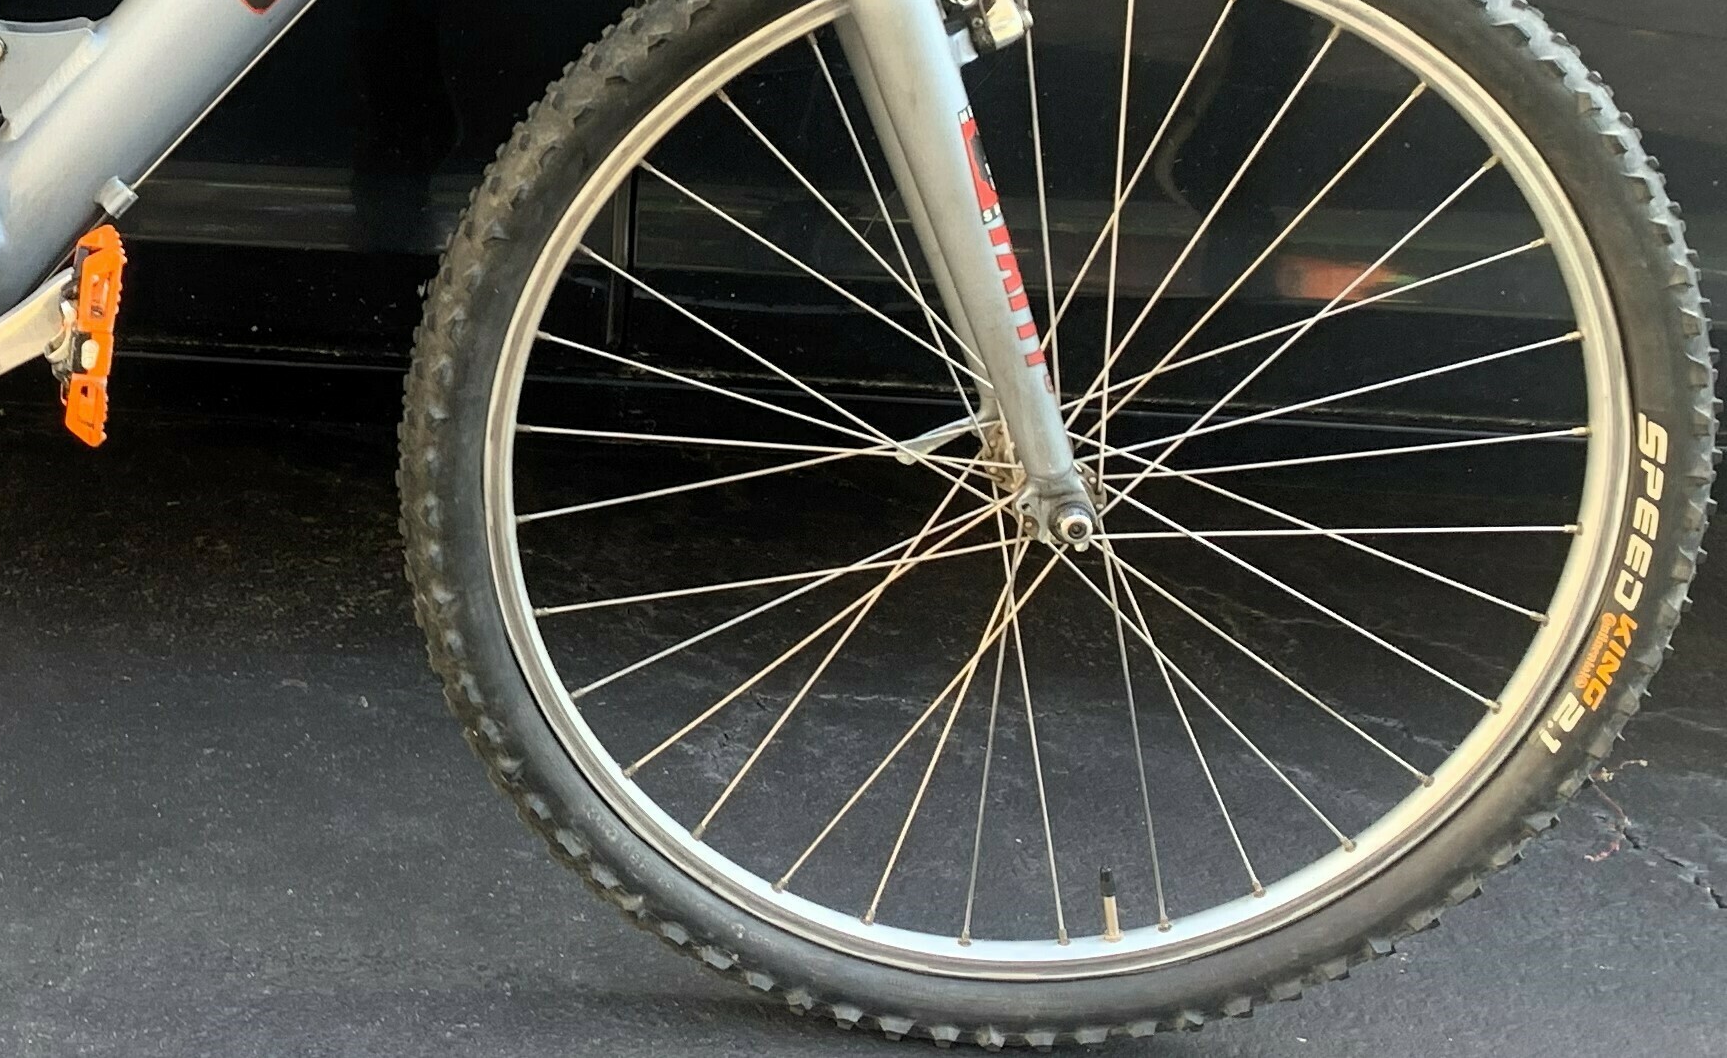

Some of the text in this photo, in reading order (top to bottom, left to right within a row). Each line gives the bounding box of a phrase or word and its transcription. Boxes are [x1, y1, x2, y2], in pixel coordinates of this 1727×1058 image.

[1539, 412, 1668, 754] SPEED KING 2.1
